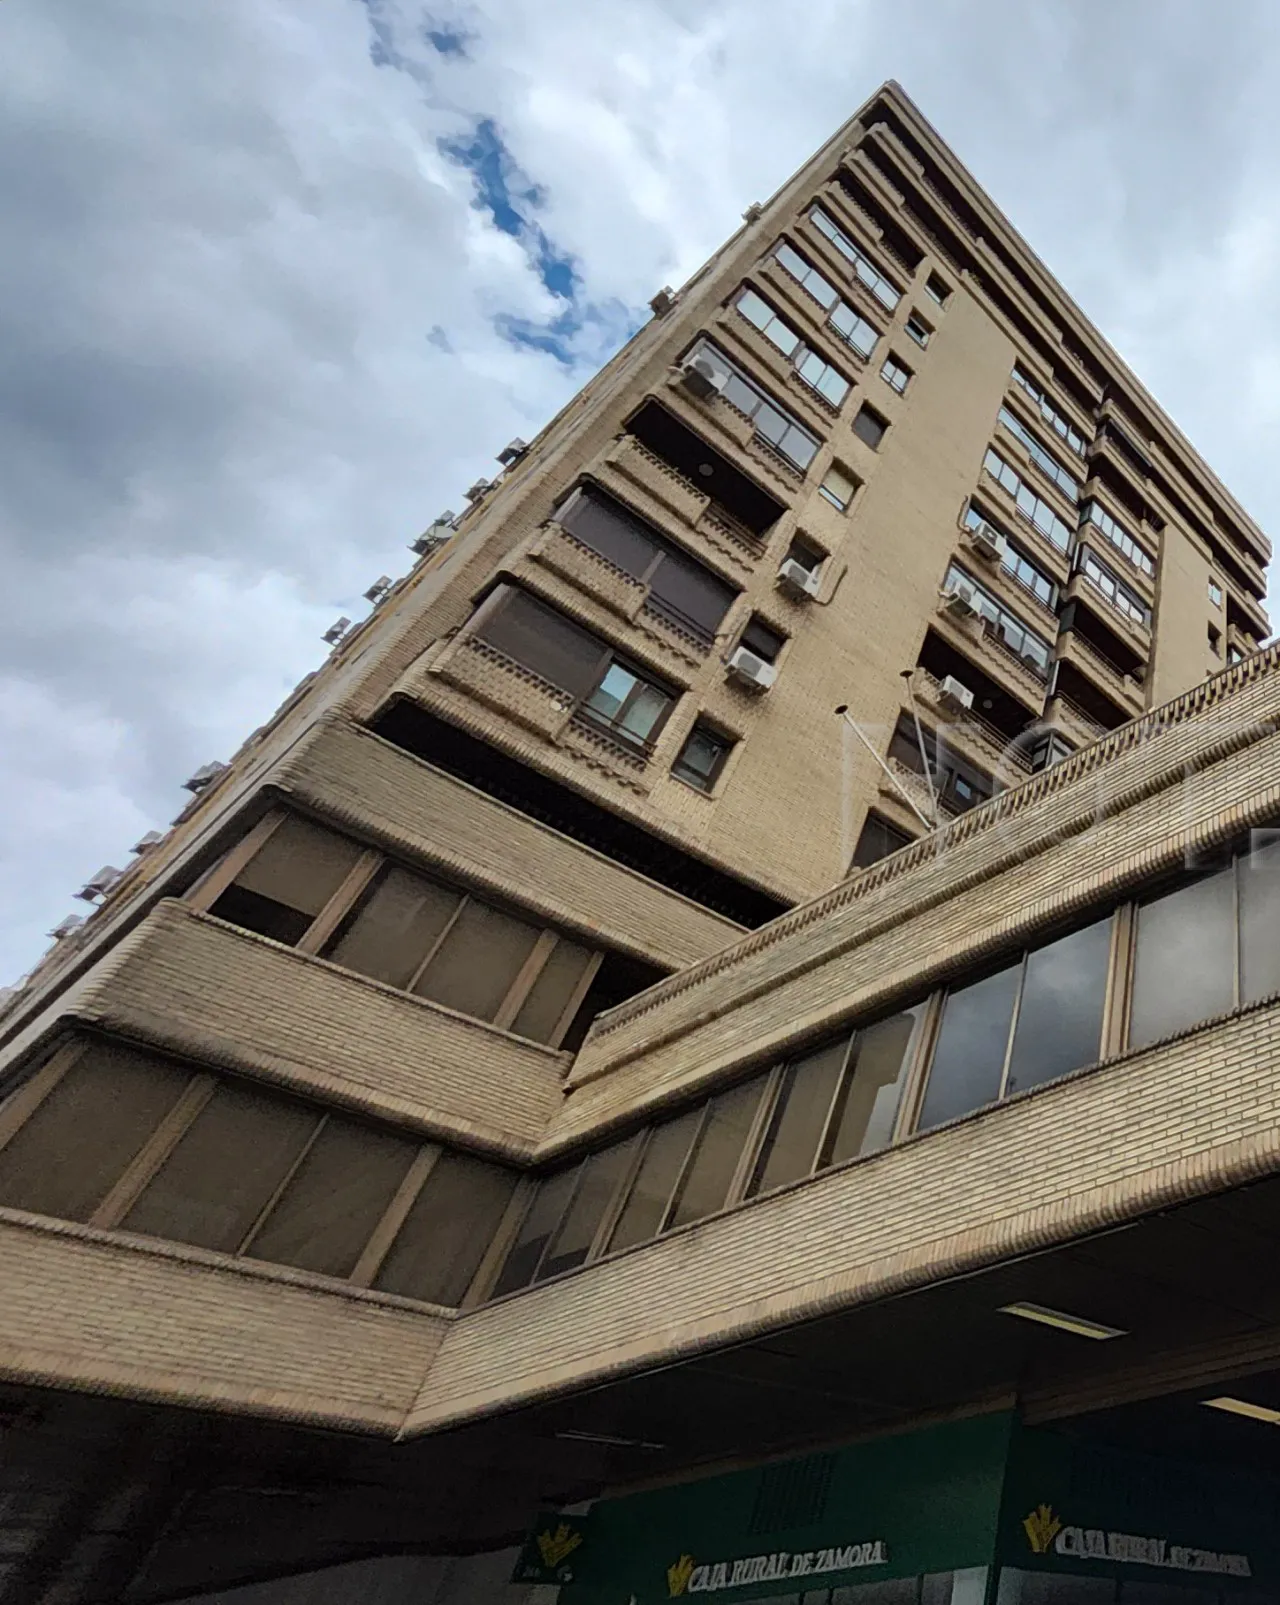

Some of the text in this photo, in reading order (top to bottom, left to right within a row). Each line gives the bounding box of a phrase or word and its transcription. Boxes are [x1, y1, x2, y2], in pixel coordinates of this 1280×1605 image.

[688, 1540, 888, 1592] CAJA RURAL DE ZAMORA
